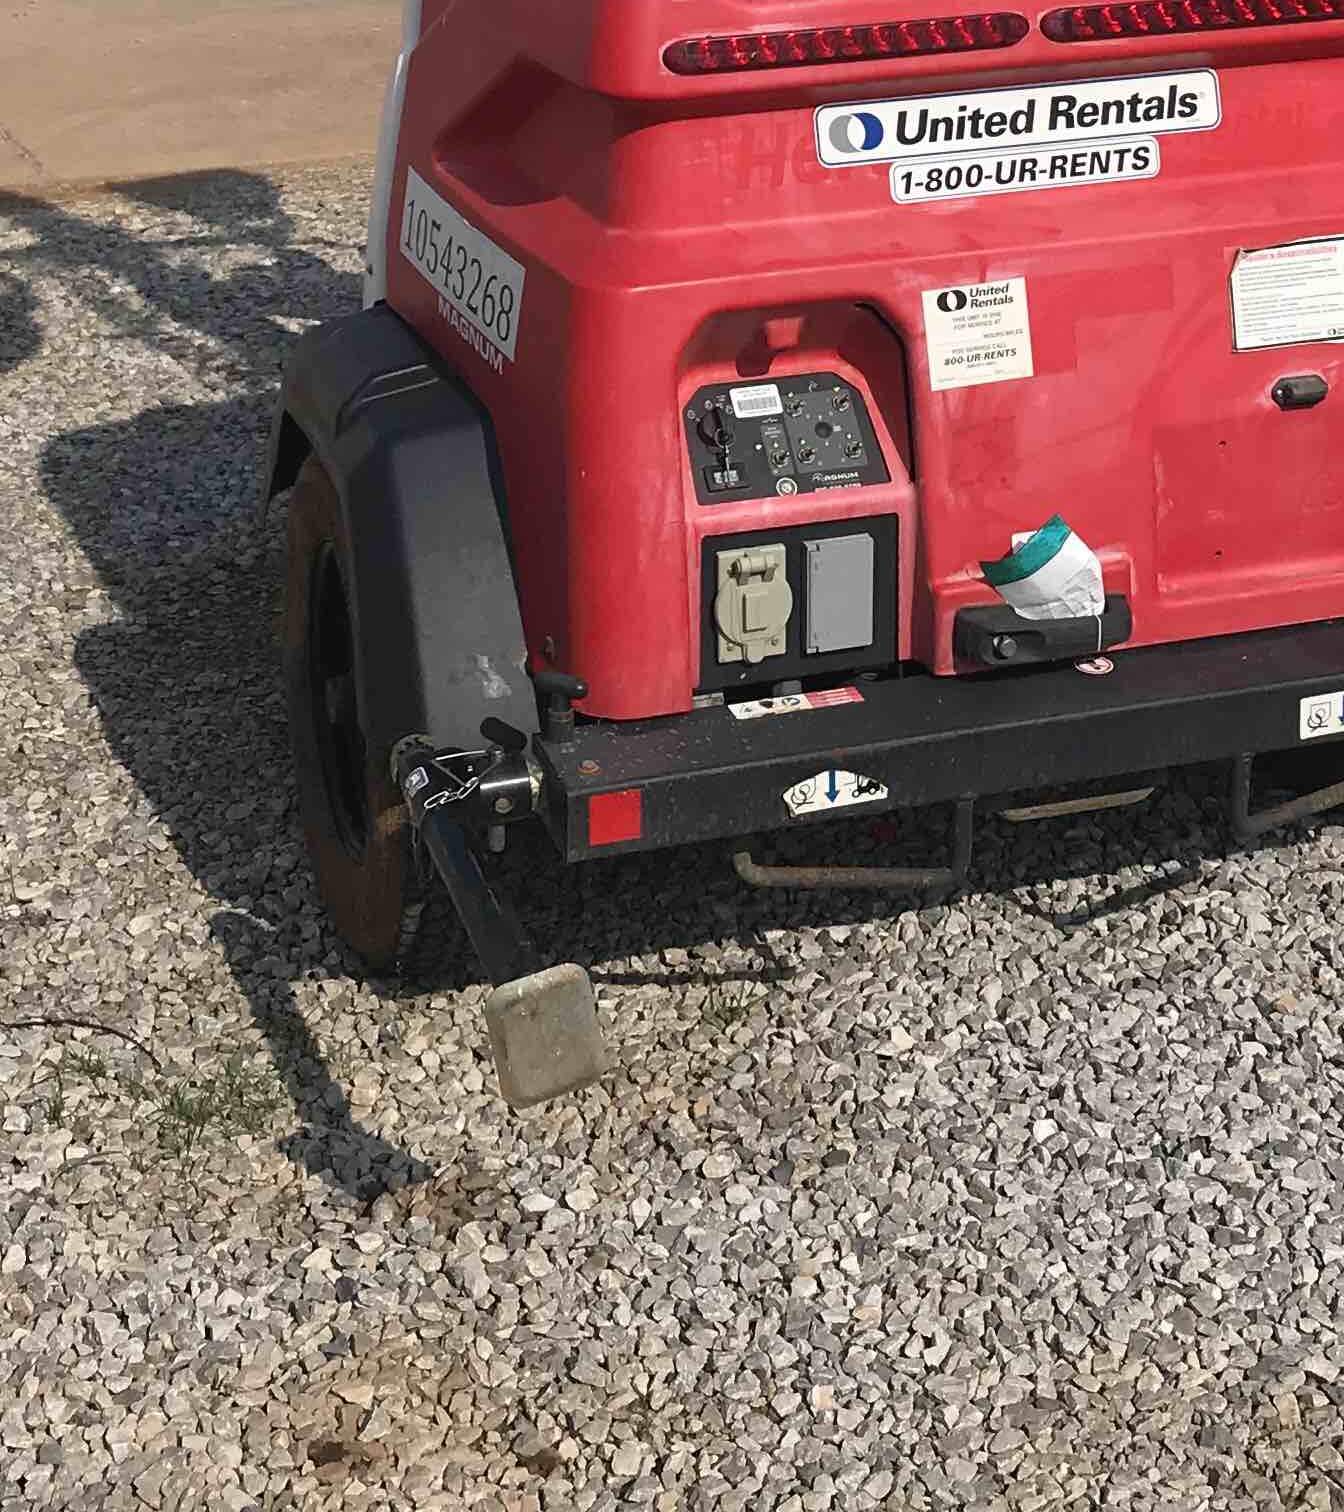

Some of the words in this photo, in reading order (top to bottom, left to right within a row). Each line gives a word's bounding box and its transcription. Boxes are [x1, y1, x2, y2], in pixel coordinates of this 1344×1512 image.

[896, 98, 1035, 146] United
[1048, 85, 1198, 131] Rentals
[899, 146, 1150, 194] 1-800-UR-RENTS
[404, 199, 514, 341] 10543268
[969, 283, 1010, 298] United
[970, 295, 1014, 309] Rentals
[437, 294, 504, 375] MAGNUM
